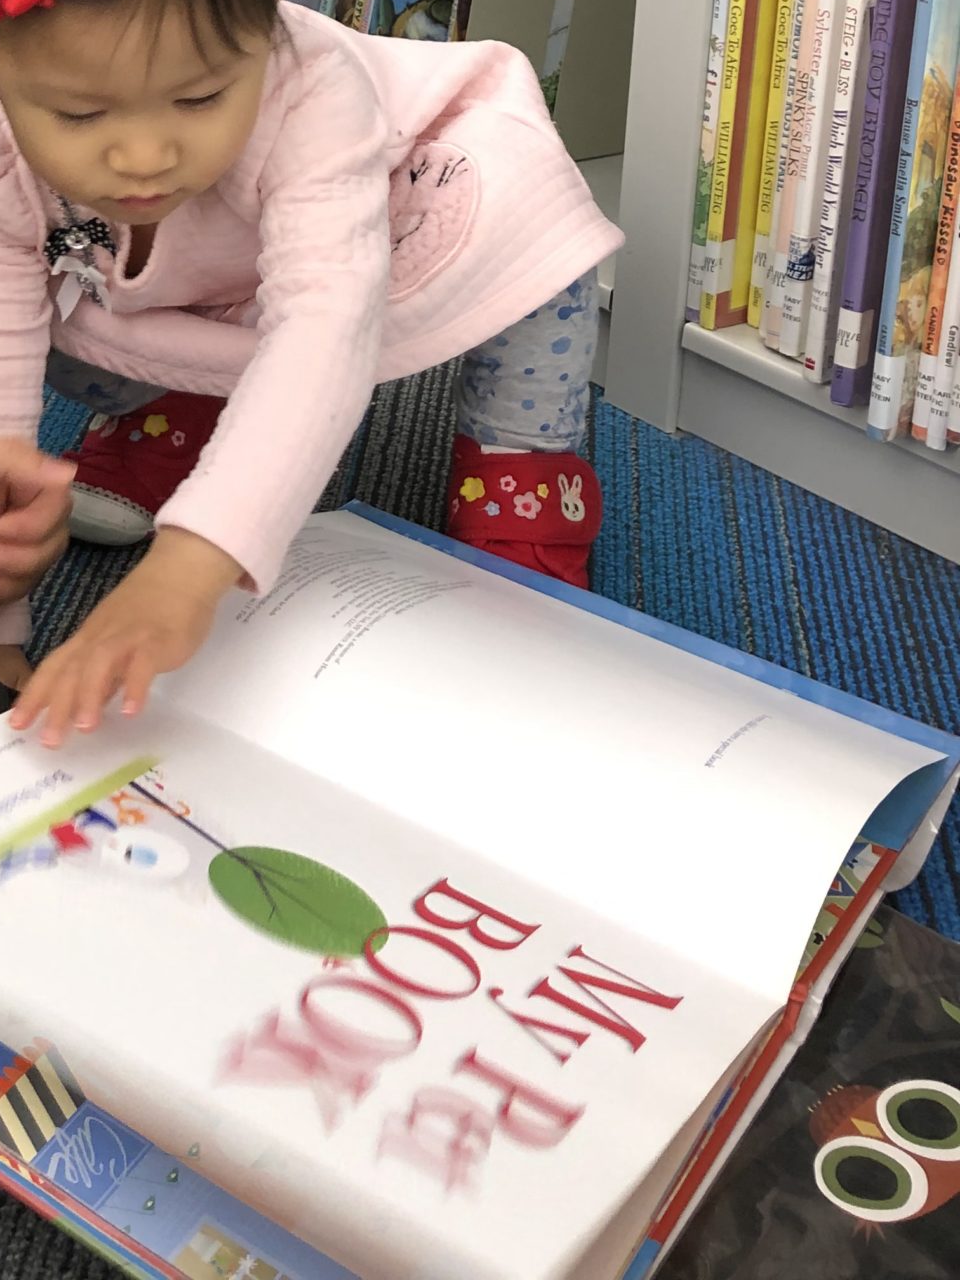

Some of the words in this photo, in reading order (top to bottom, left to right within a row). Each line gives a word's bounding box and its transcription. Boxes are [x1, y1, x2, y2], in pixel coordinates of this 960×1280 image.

[730, 4, 742, 37] Goes
[778, 4, 791, 37] Goes
[842, 6, 858, 46] STEIG
[727, 37, 741, 54] To
[775, 37, 789, 54] To
[809, 8, 830, 77] Sylvester
[723, 55, 739, 89] Africa
[772, 55, 787, 89] Africa
[837, 59, 852, 95] BLISS
[866, 49, 886, 102] TOY
[792, 71, 809, 129] SPINKY
[829, 110, 847, 153] Which
[903, 97, 919, 147] Because
[716, 121, 731, 174] WILLIAM
[764, 120, 779, 173] WILLIAM
[787, 130, 803, 177] SULKS
[944, 131, 960, 201] Dinosaur
[712, 174, 726, 214] STEIG
[760, 174, 775, 214] STEIG
[823, 155, 843, 196] Would
[820, 196, 837, 224] You
[891, 195, 907, 237] Smiled
[814, 223, 834, 269] Rather
[936, 205, 954, 260] Kisses
[212, 877, 542, 1137] BOOK
[488, 945, 684, 1067] My
